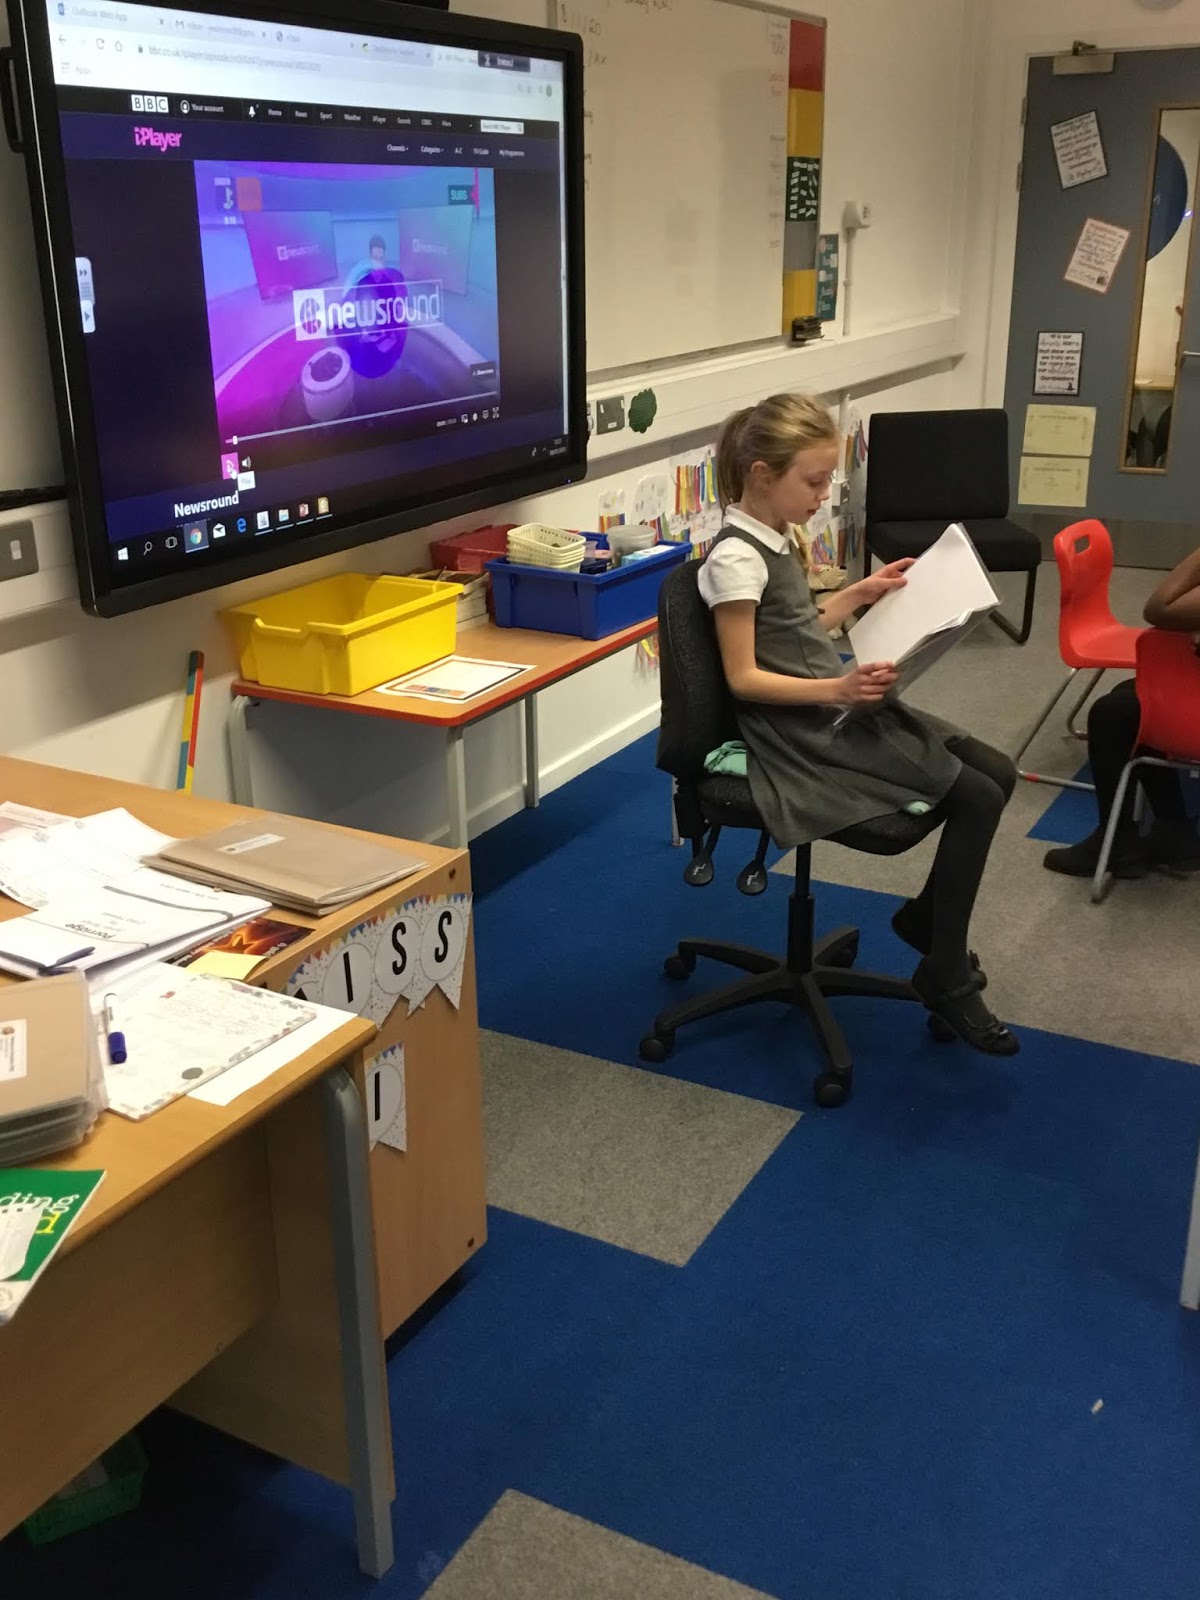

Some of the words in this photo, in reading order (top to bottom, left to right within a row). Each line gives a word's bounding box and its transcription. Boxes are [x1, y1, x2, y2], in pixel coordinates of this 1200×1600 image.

[132, 95, 168, 112] BBC
[134, 126, 182, 153] iPlayer
[327, 284, 440, 331] newsround
[174, 490, 240, 518] Newsround
